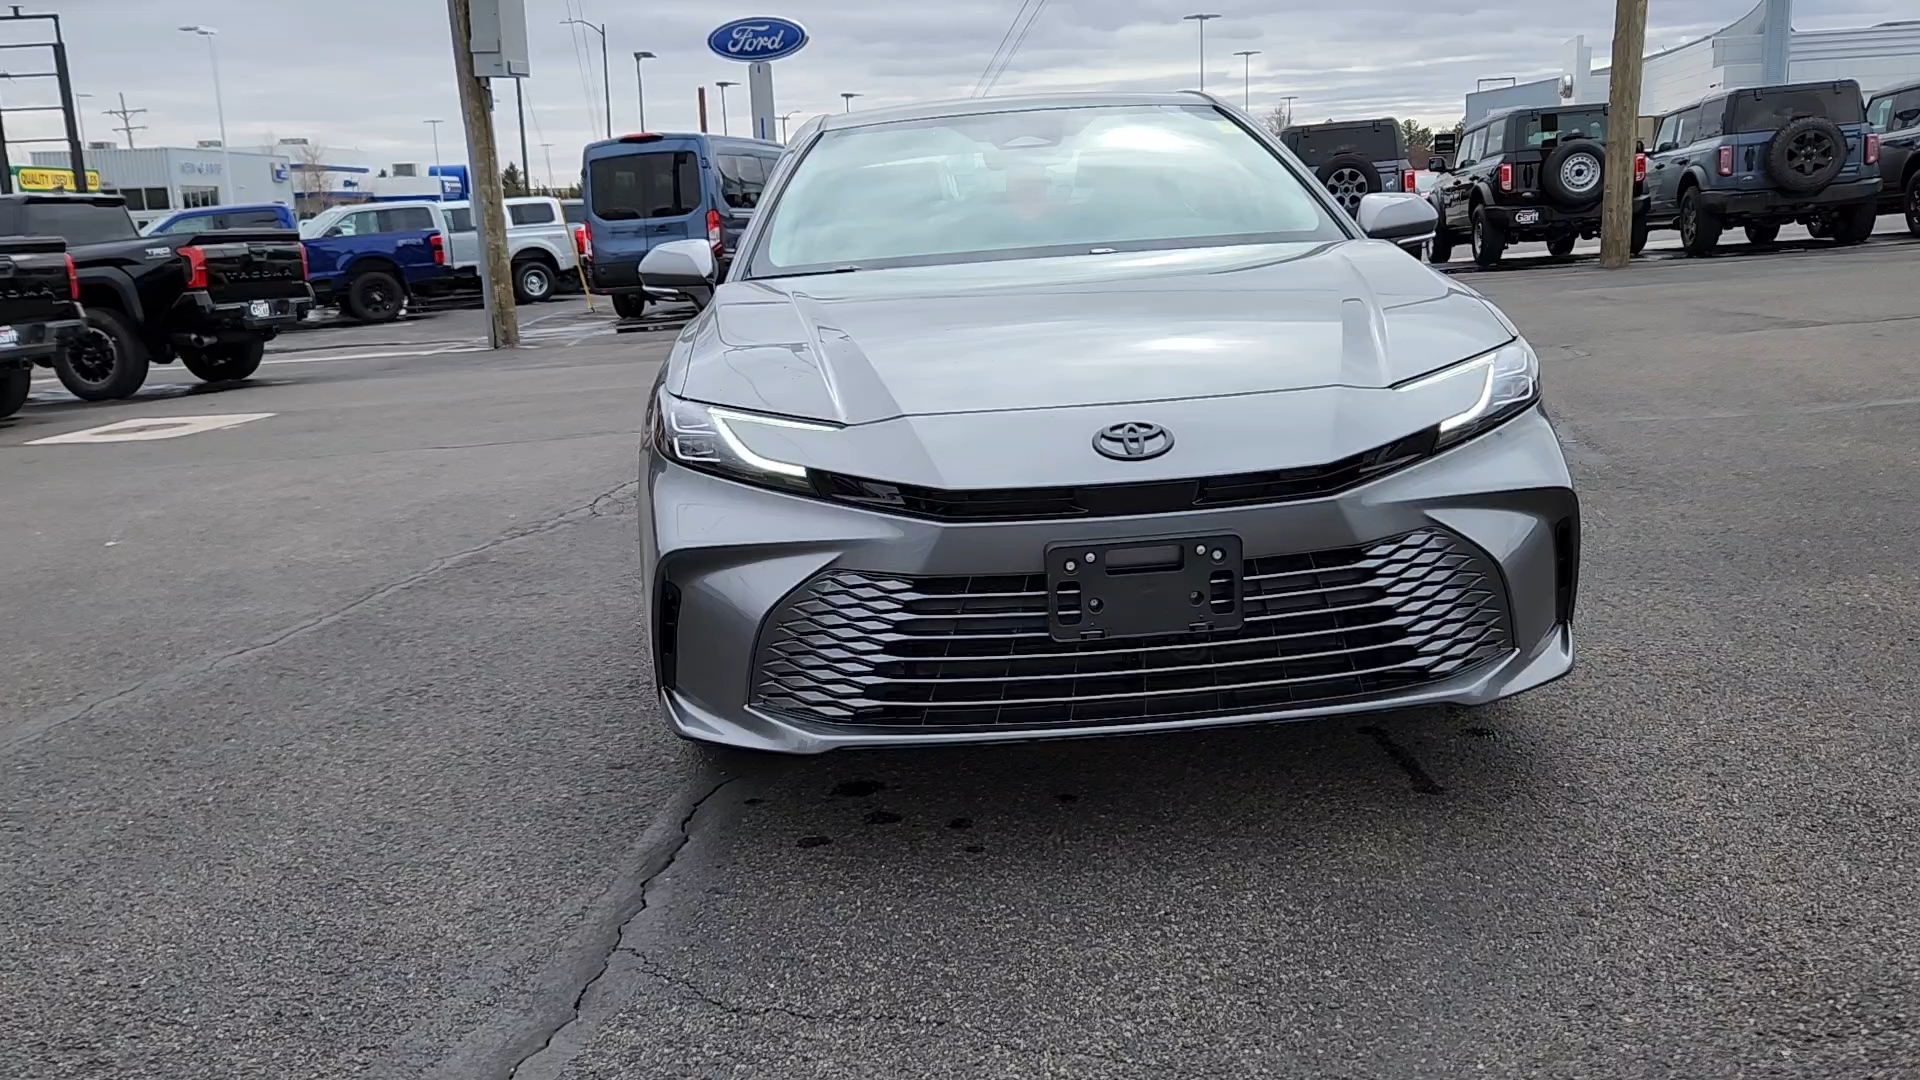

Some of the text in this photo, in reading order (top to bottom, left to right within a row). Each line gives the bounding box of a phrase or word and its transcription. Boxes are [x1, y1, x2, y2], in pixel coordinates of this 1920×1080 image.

[727, 24, 785, 53] Ford
[21, 172, 98, 187] QUALITY USED VLES
[1515, 211, 1539, 223] Garff
[145, 247, 171, 256] TRD
[226, 268, 293, 280] TACOMA
